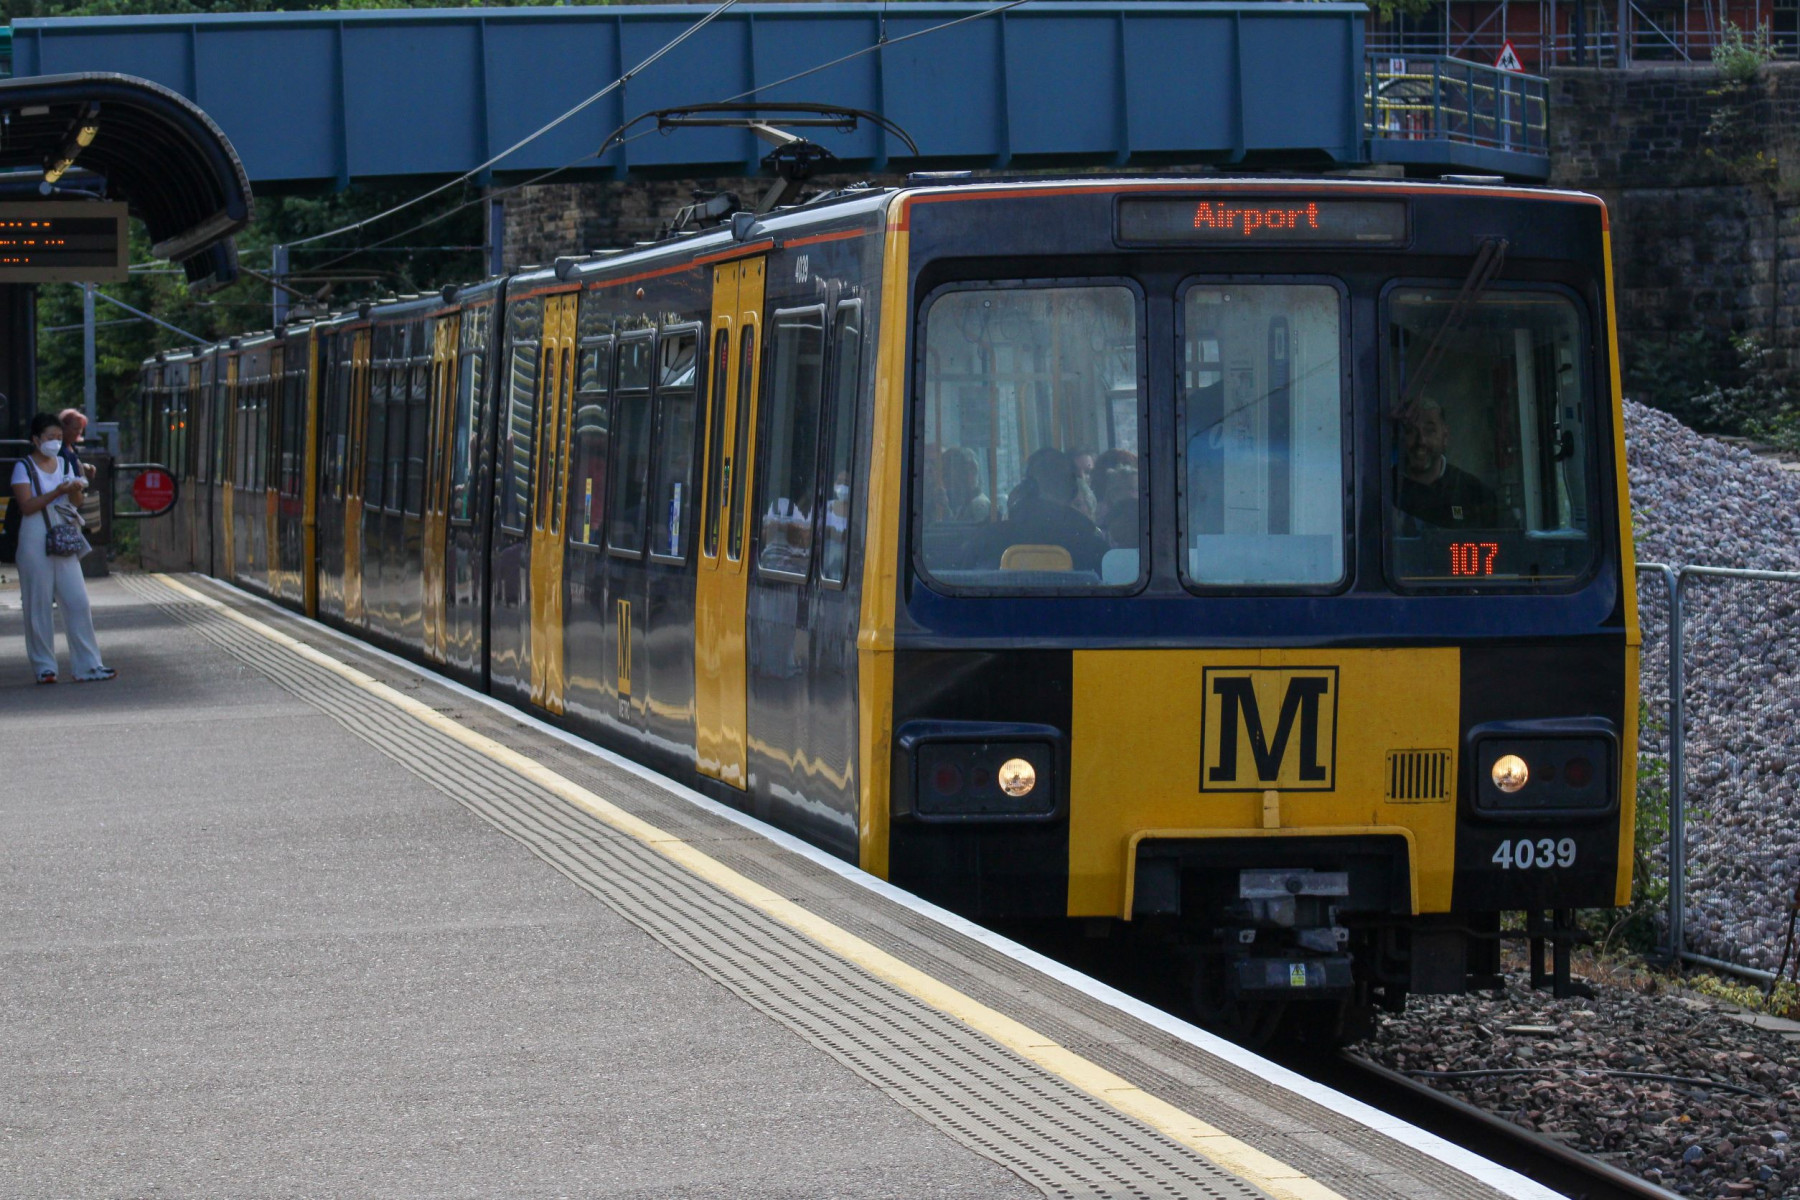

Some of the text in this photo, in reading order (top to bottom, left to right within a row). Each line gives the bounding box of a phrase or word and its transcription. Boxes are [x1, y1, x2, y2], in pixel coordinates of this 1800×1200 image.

[1194, 202, 1318, 234] Airport
[1449, 542, 1498, 575] 107
[618, 601, 630, 680] M
[1209, 676, 1329, 782] M
[1491, 837, 1577, 870] 4039
